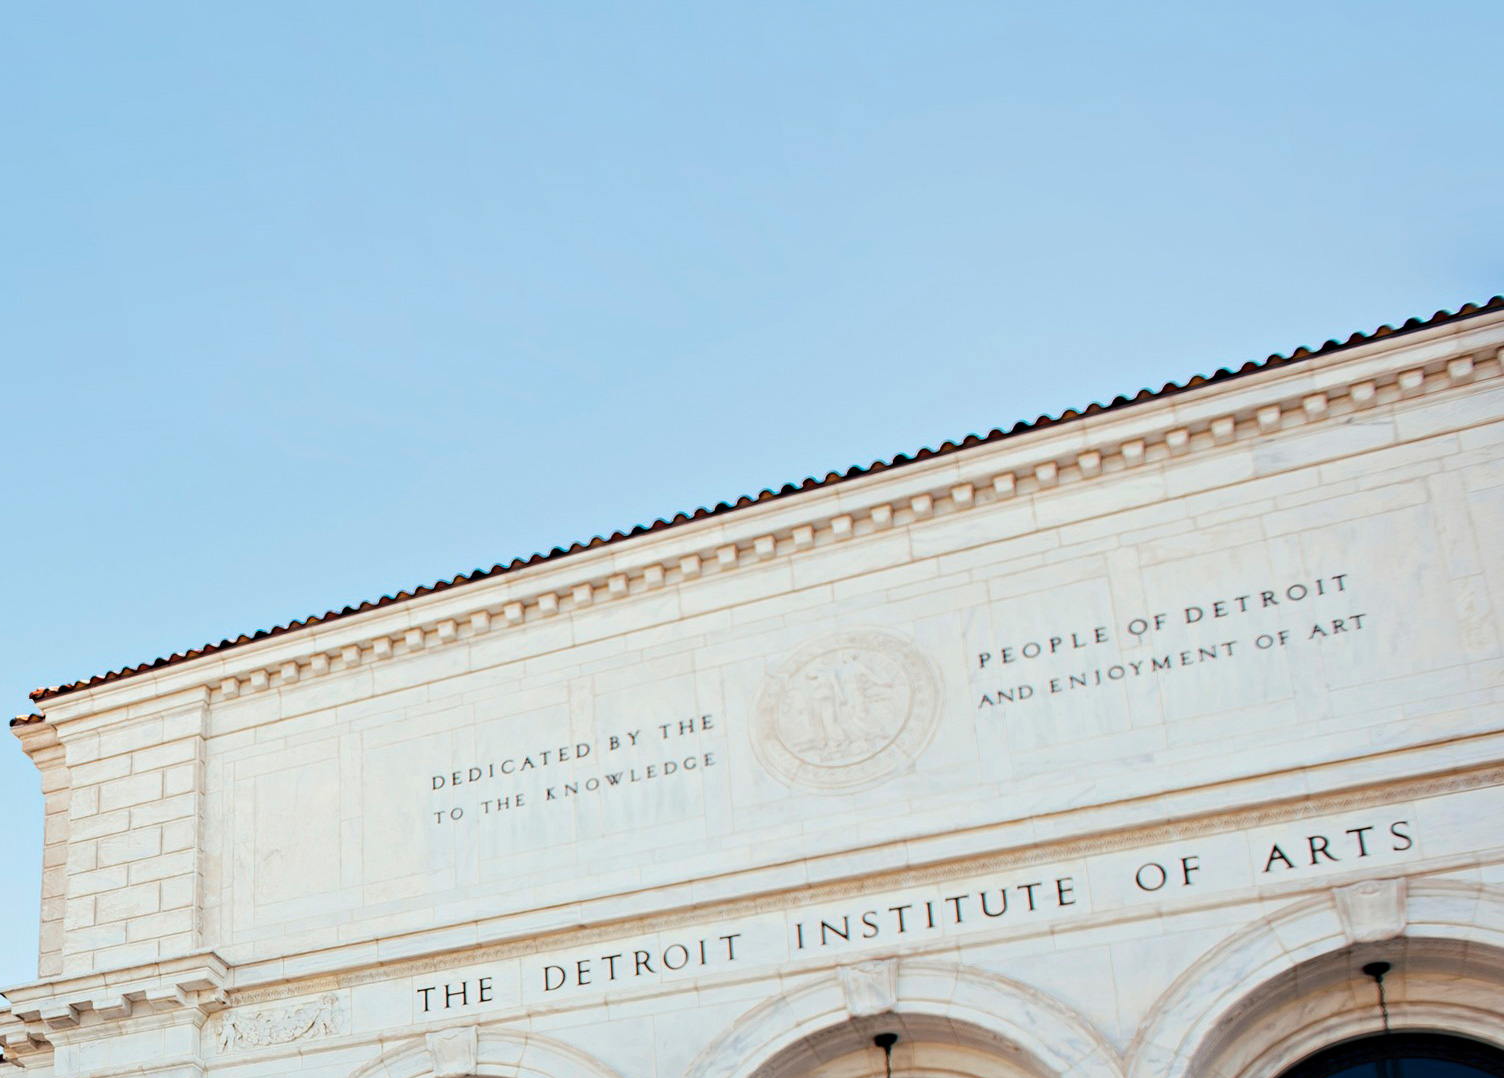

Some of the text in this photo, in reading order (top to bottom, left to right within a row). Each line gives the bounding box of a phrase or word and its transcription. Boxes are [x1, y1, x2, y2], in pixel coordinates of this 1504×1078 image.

[977, 613, 1367, 709] AND ENJOYMENT OF ART
[978, 573, 1349, 669] PEOPLE OF DETROIT
[432, 714, 715, 790] DEDICATED BY THE
[433, 752, 716, 824] TO THE KNOWLEDGE
[417, 819, 1414, 1013] THE DETROIT INSTITUTE OF ARTS
